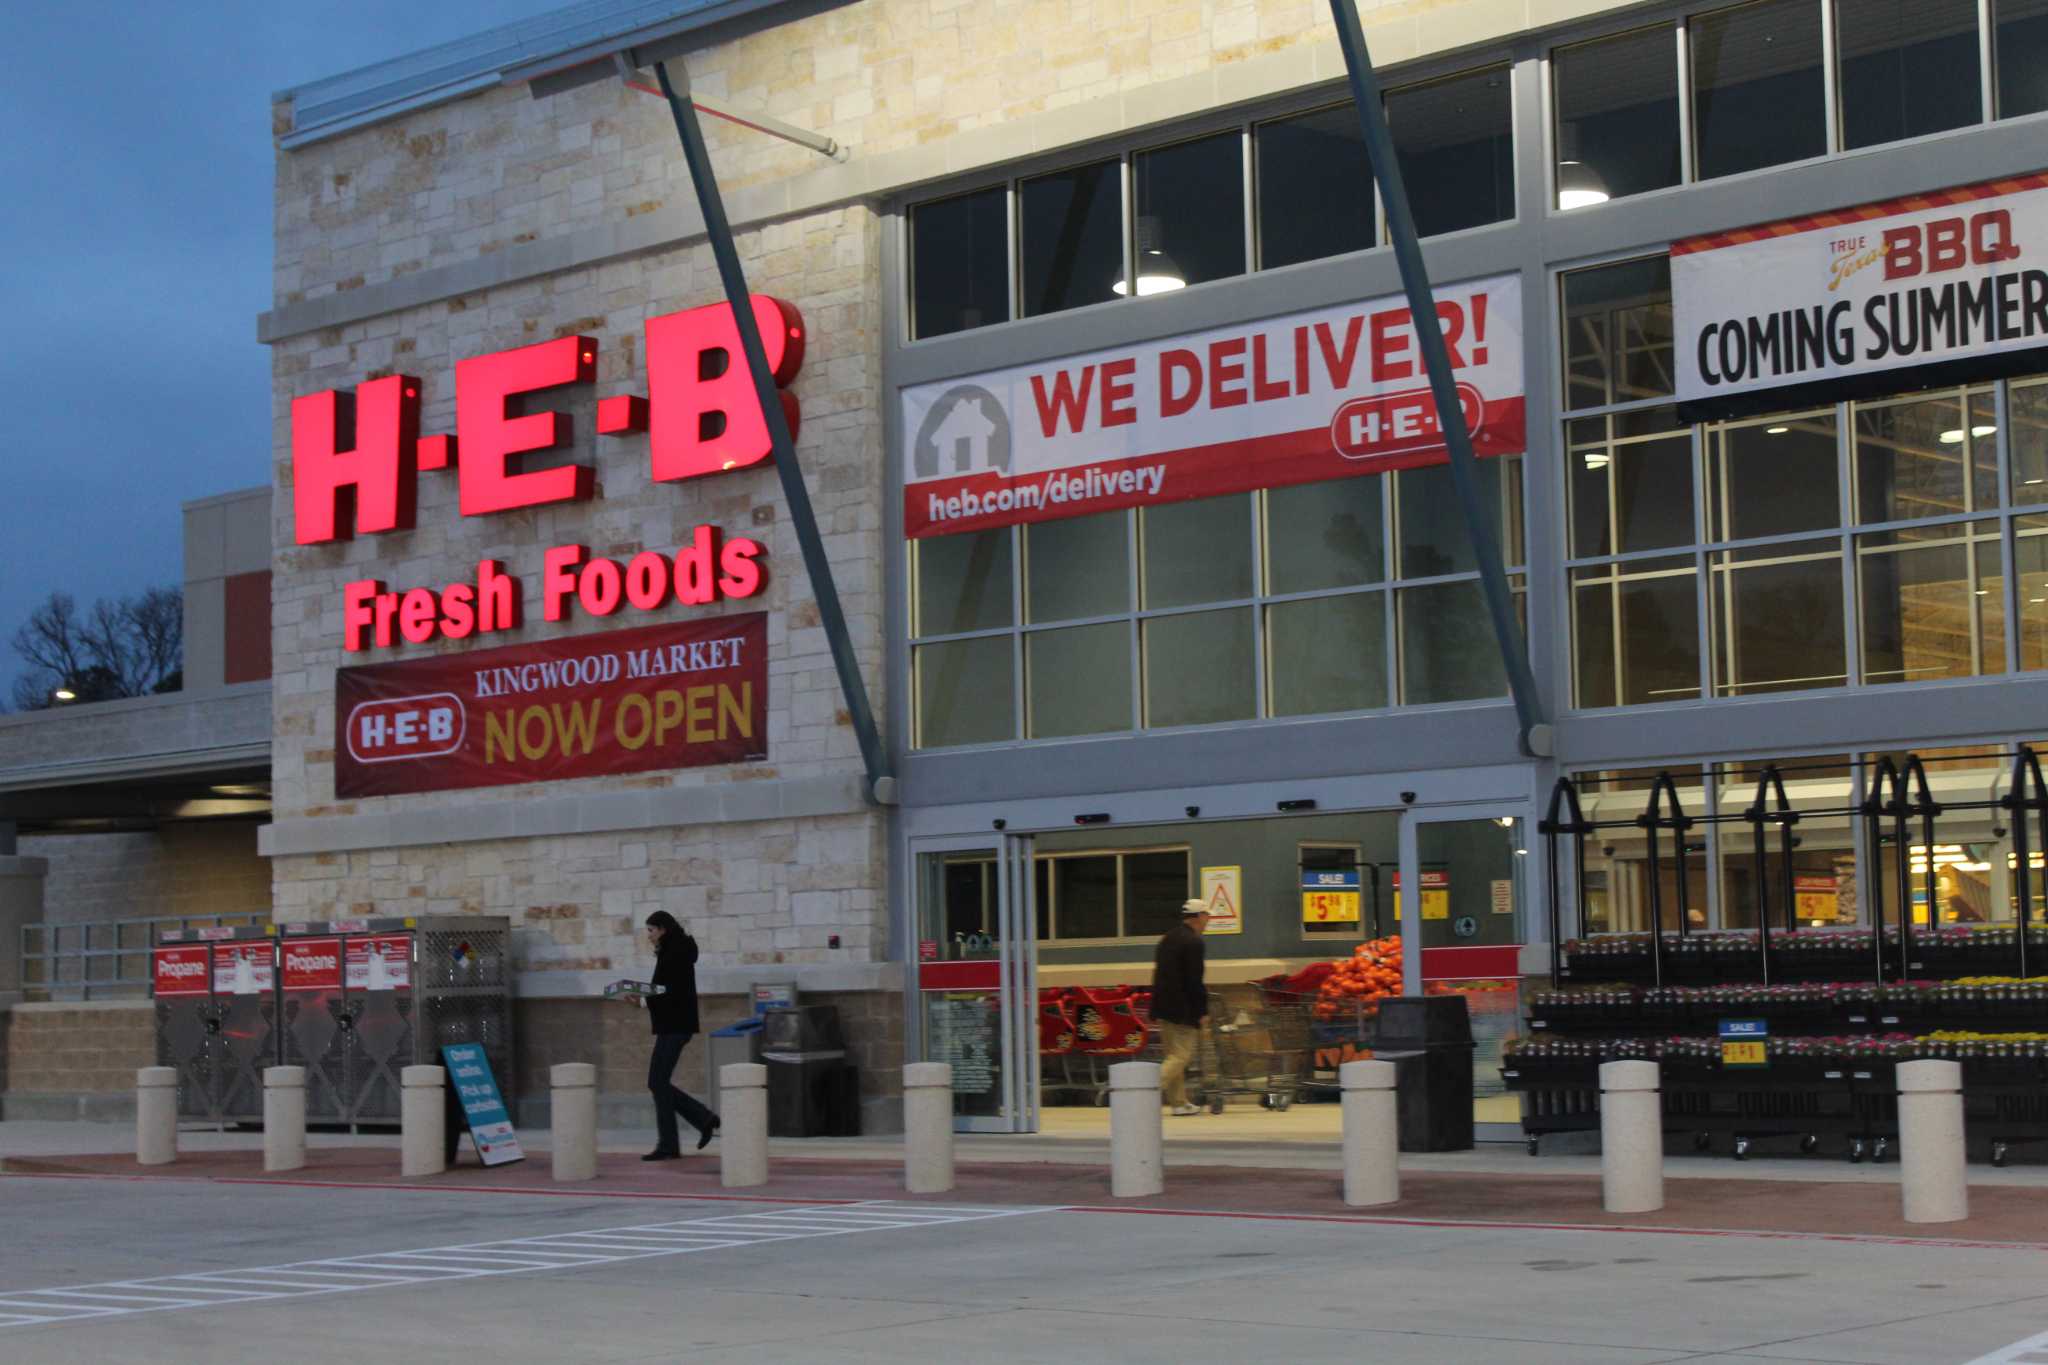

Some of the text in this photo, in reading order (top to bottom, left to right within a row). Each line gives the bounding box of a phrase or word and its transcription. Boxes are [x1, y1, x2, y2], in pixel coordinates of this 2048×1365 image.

[1829, 236, 1866, 254] TRUE
[1882, 208, 2022, 281] BBQ
[1697, 269, 2048, 386] COMING SUMMER
[1030, 293, 1489, 438] WE DELIVER!
[928, 463, 1166, 523] heb.com/delivery
[343, 524, 768, 652] Fresh Foods
[475, 636, 746, 698] KINGWOOD MARKET
[484, 681, 753, 765] NOW OPEN
[158, 960, 206, 980] Propane
[286, 954, 337, 974] Propane
